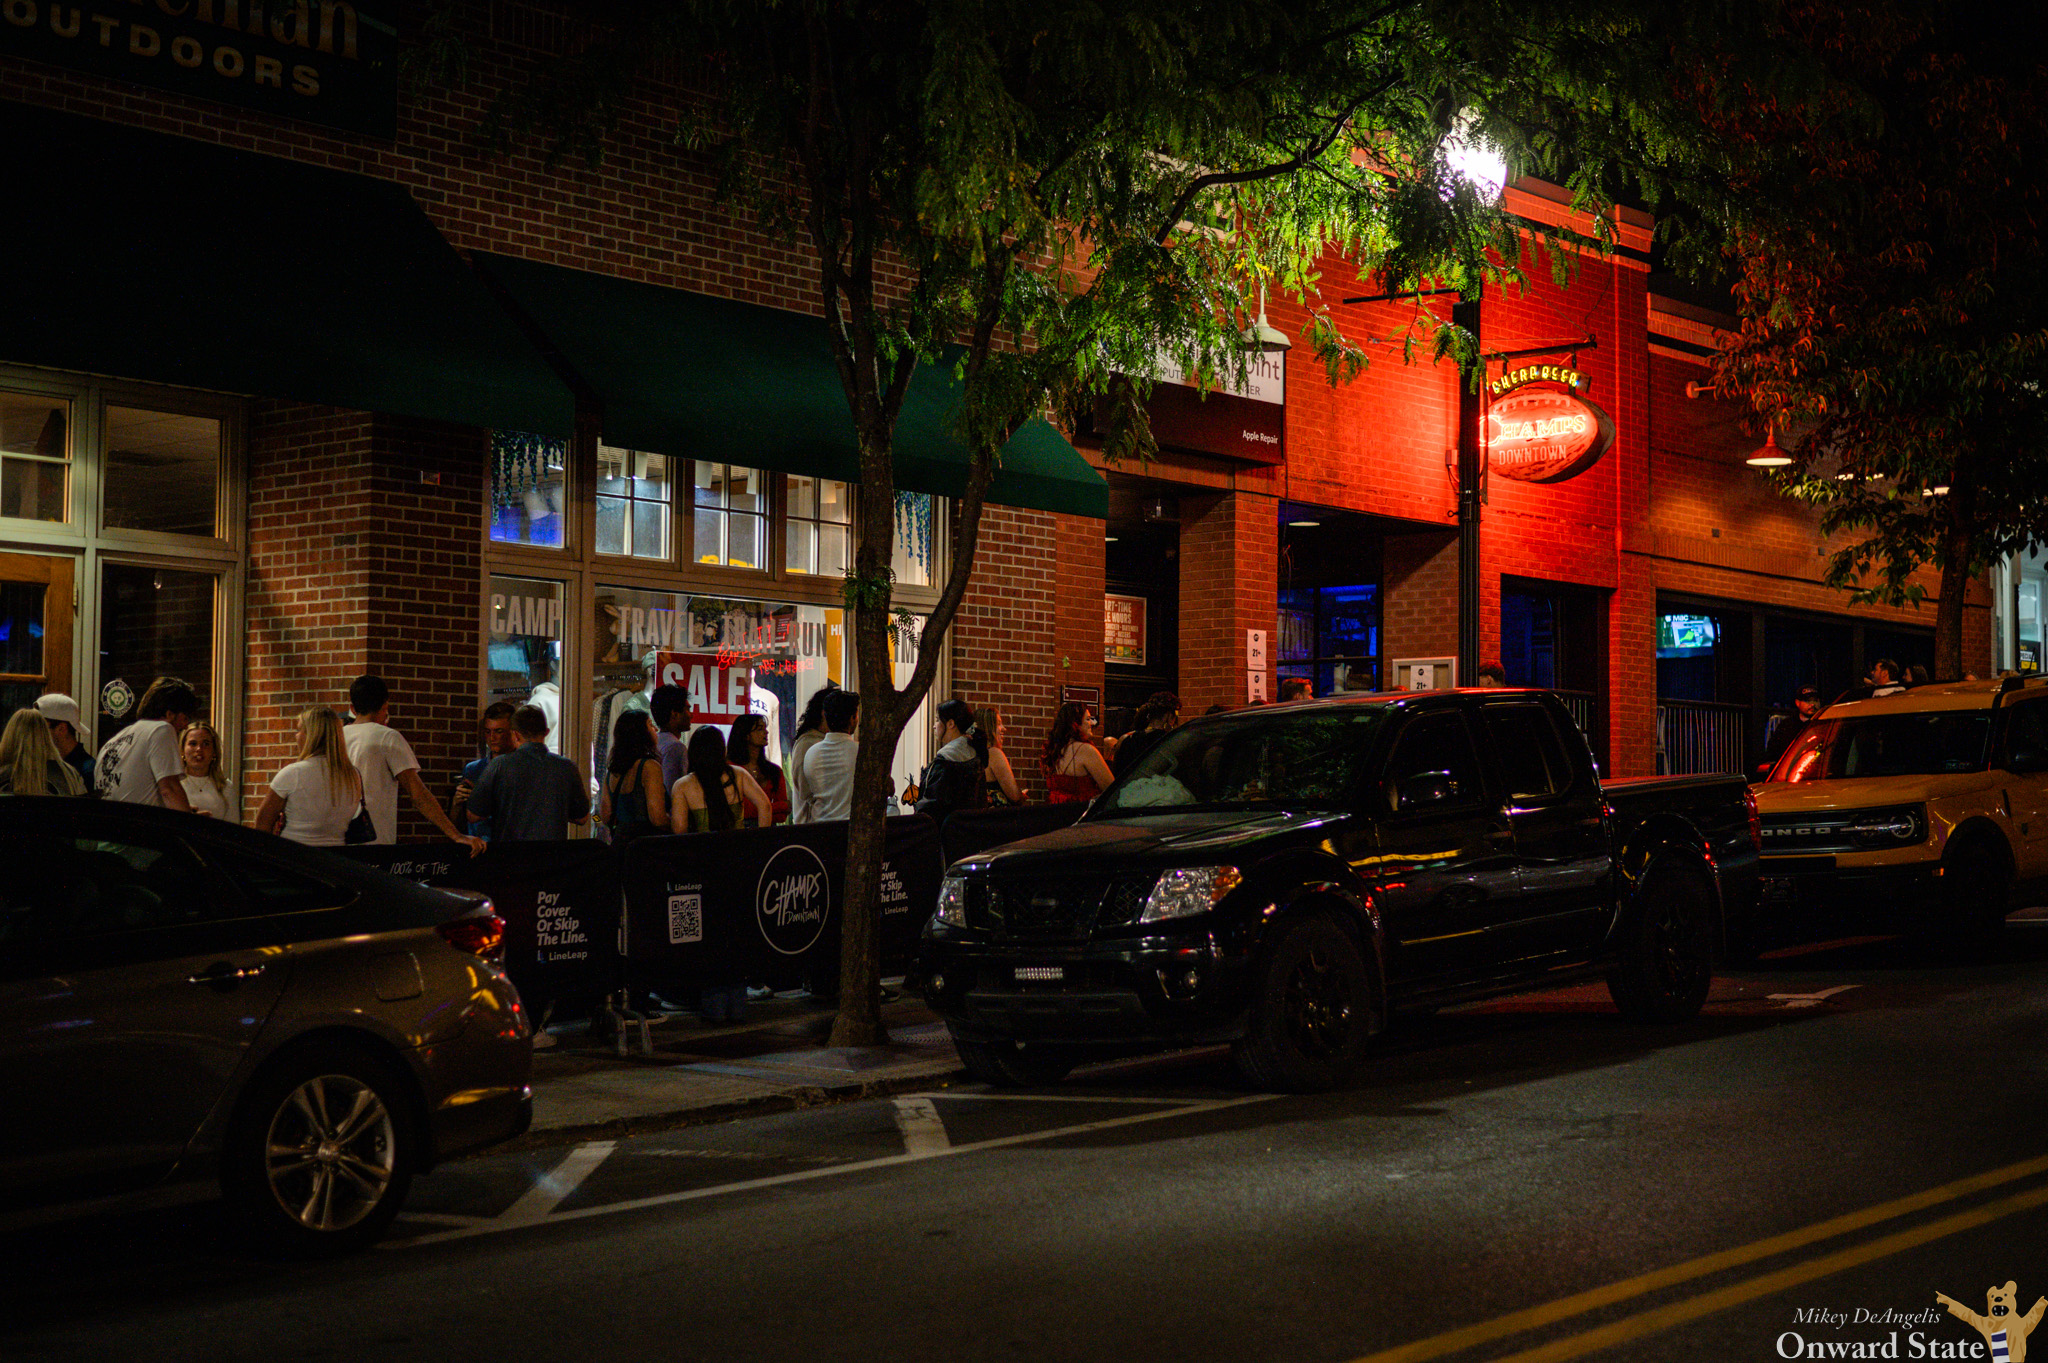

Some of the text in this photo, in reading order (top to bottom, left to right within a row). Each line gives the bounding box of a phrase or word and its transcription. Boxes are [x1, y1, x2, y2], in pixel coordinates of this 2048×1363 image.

[3, 0, 322, 98] OUTDOORS
[1242, 429, 1278, 444] Apple Repair
[1479, 414, 1587, 447] CHAMPS
[1499, 444, 1567, 465] DOWNTOWN
[490, 593, 560, 638] CAMP
[618, 605, 704, 648] TRAVEL
[721, 614, 781, 655] TRAIL
[788, 620, 828, 658] RUN
[662, 662, 747, 716] SALE
[1416, 681, 1427, 690] 21+
[1760, 827, 1831, 837] ONCO
[390, 860, 413, 875] 100%
[416, 863, 430, 873] OF
[431, 861, 451, 875] THE
[881, 871, 897, 881] over
[675, 883, 703, 891] LineLeap
[887, 879, 903, 891] Skip
[537, 891, 560, 905] Pay
[763, 872, 822, 927] CHAMPS
[537, 905, 571, 918] Cover
[884, 906, 909, 915] LineLeap
[536, 917, 580, 932] Or Skip
[536, 931, 588, 946] The Line.
[548, 950, 588, 961] LineLeap
